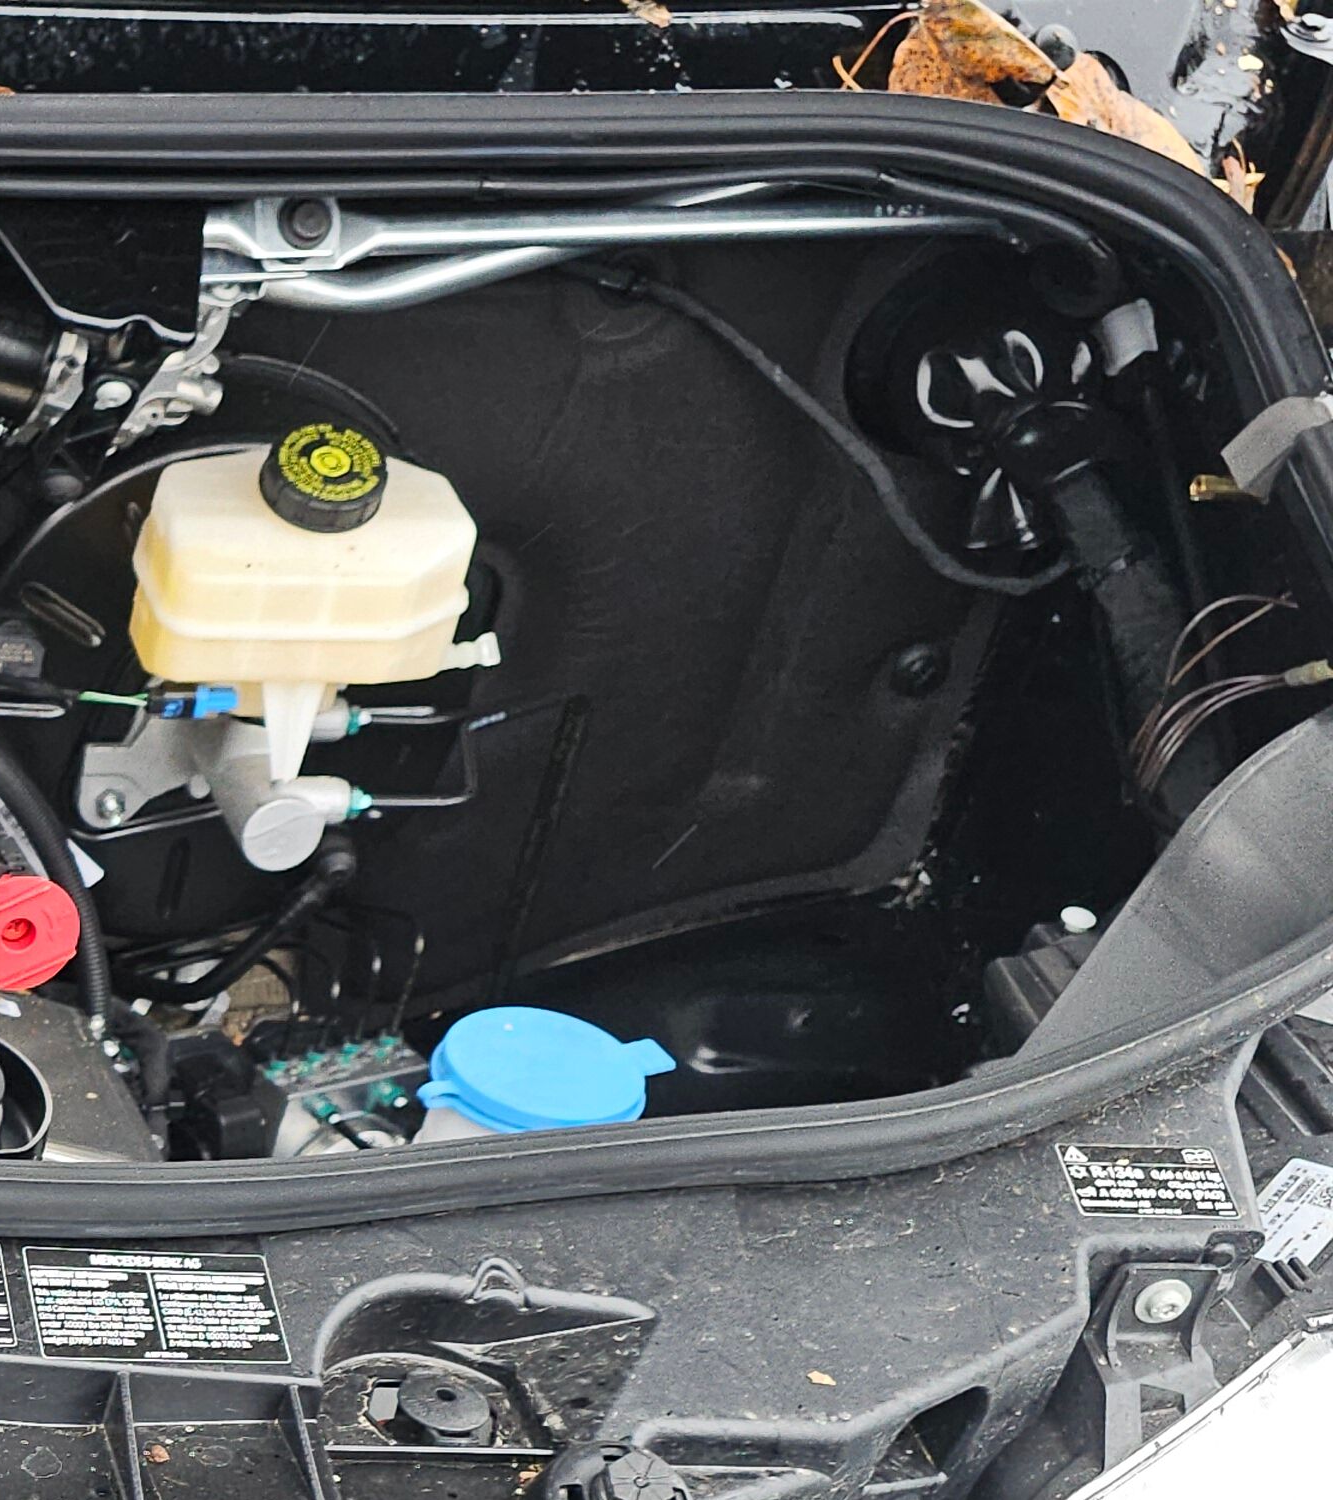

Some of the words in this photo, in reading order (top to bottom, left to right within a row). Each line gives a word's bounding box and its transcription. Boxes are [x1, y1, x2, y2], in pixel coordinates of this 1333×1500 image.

[1088, 1165, 1145, 1178] R-134a
[1096, 1187, 1109, 1197] A
[89, 1254, 183, 1267] MERCEDES-BENZ
[182, 1258, 202, 1268] AG
